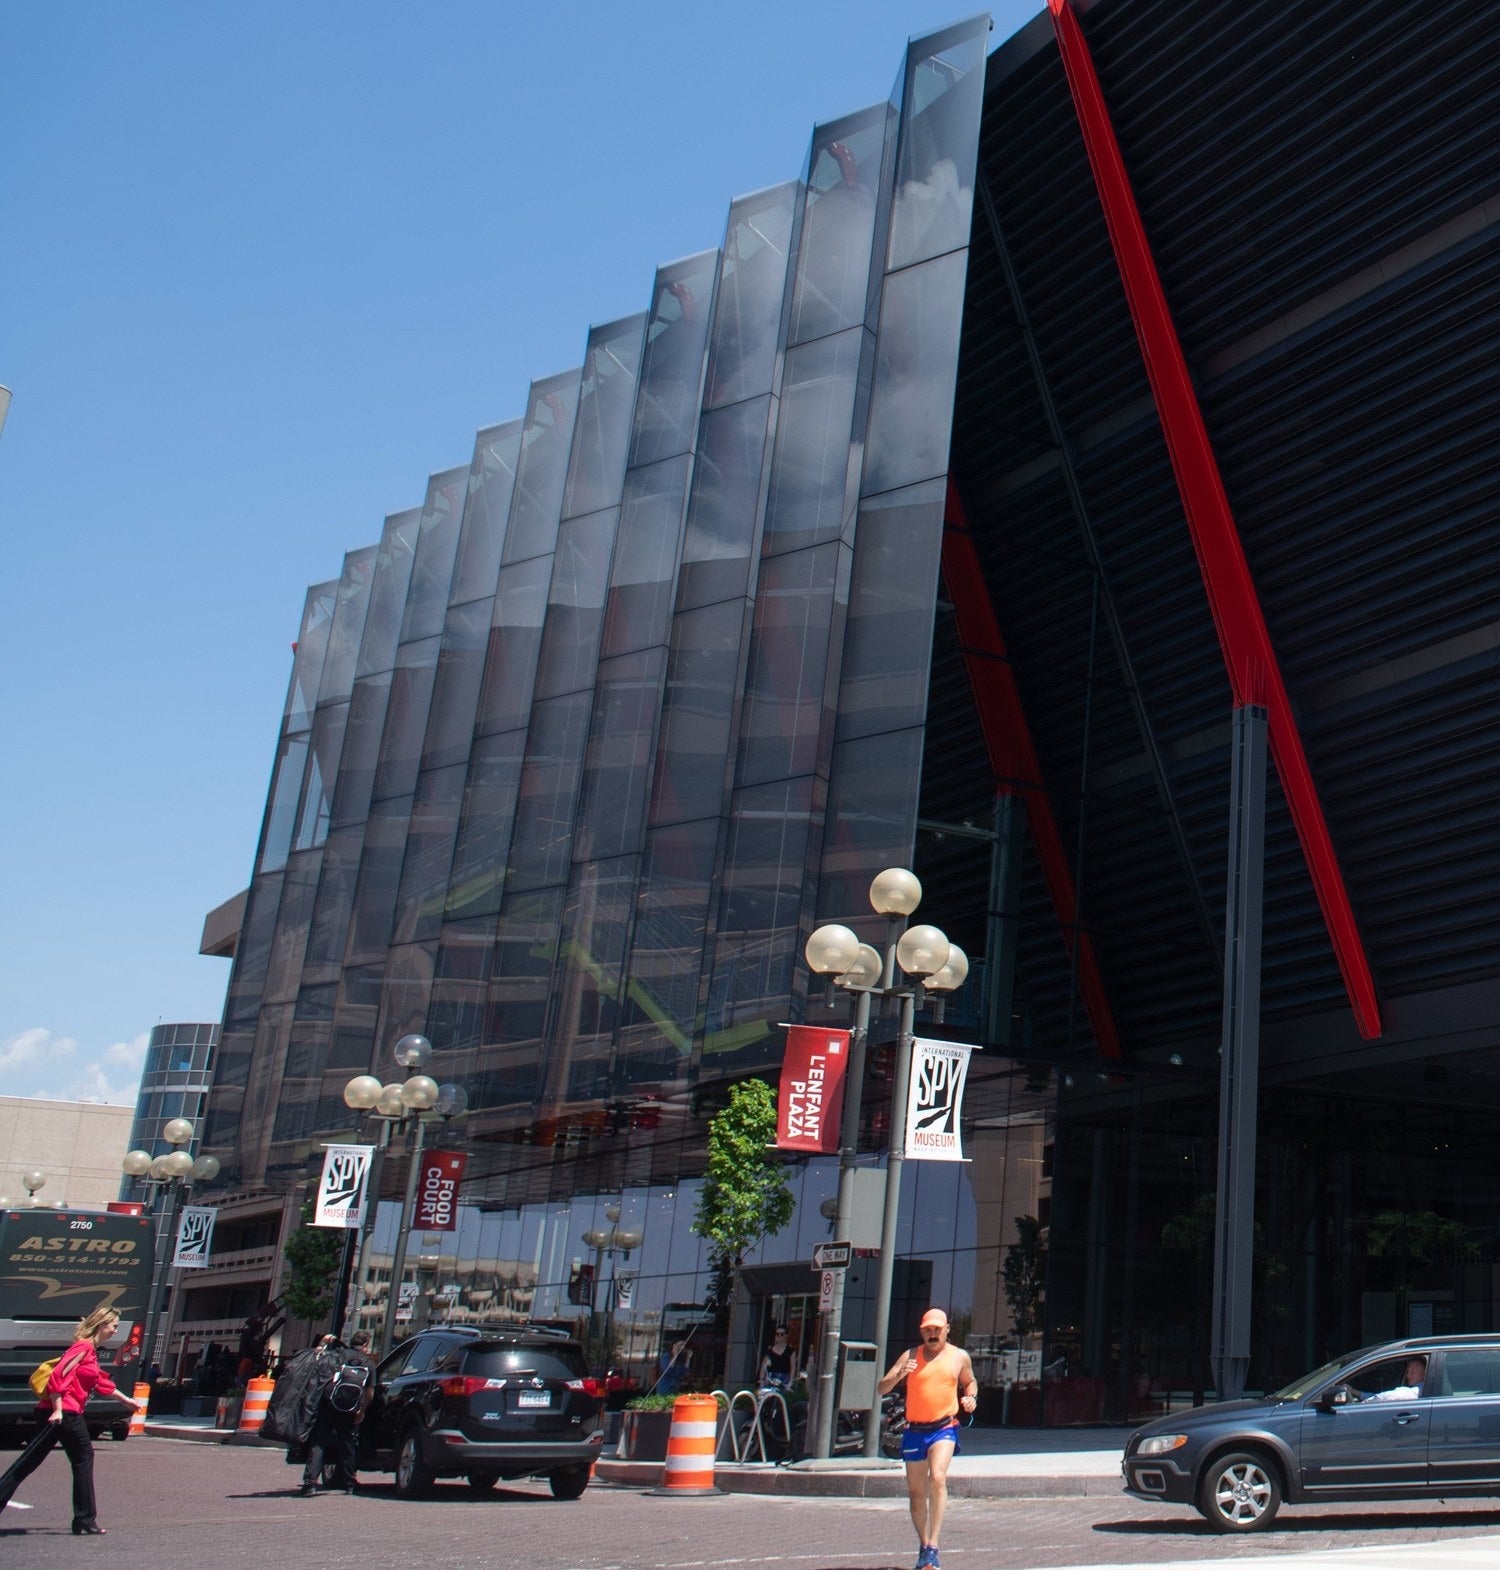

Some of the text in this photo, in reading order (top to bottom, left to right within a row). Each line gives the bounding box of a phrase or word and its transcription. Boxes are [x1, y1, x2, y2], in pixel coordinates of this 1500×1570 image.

[922, 1047, 964, 1058] INTERNATIONAL
[918, 1056, 962, 1107] SPY
[803, 1055, 825, 1140] L'ENFANT
[788, 1081, 806, 1138] PLAZA
[914, 1132, 955, 1147] MUSEUM
[328, 1155, 367, 1191] SPY
[420, 1167, 442, 1225] COURT
[435, 1179, 455, 1225] FOOD
[323, 1208, 359, 1218] MUSEUM
[70, 1221, 93, 1230] 2750
[183, 1214, 213, 1240] SPY
[18, 1236, 137, 1253] ASTRO
[9, 1254, 140, 1266] 850-514-1793
[823, 1250, 845, 1261] ONE WAY
